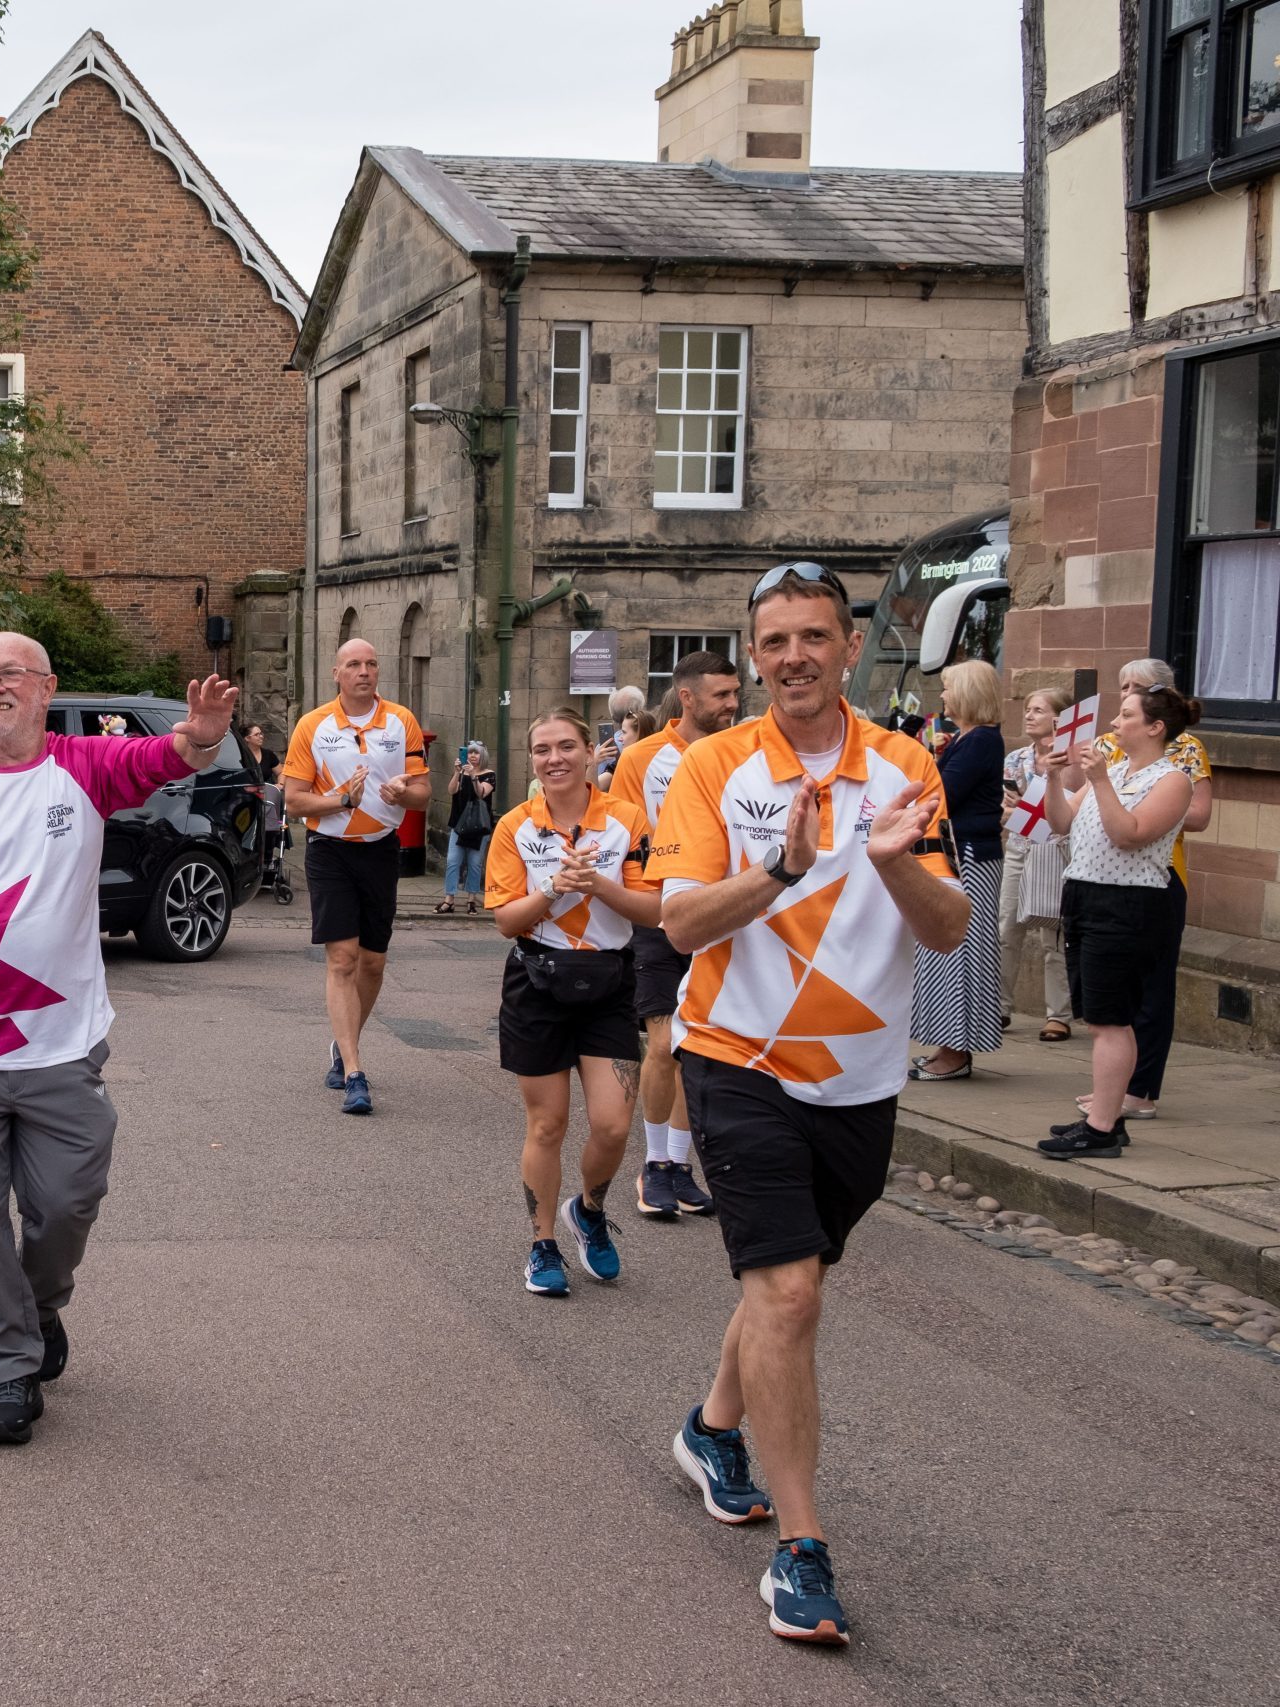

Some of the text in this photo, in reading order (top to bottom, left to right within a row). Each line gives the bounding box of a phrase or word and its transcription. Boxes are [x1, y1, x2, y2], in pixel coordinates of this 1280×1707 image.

[921, 554, 997, 579] Birmingham 2022
[47, 817, 65, 829] RELAY
[749, 832, 772, 841] sport
